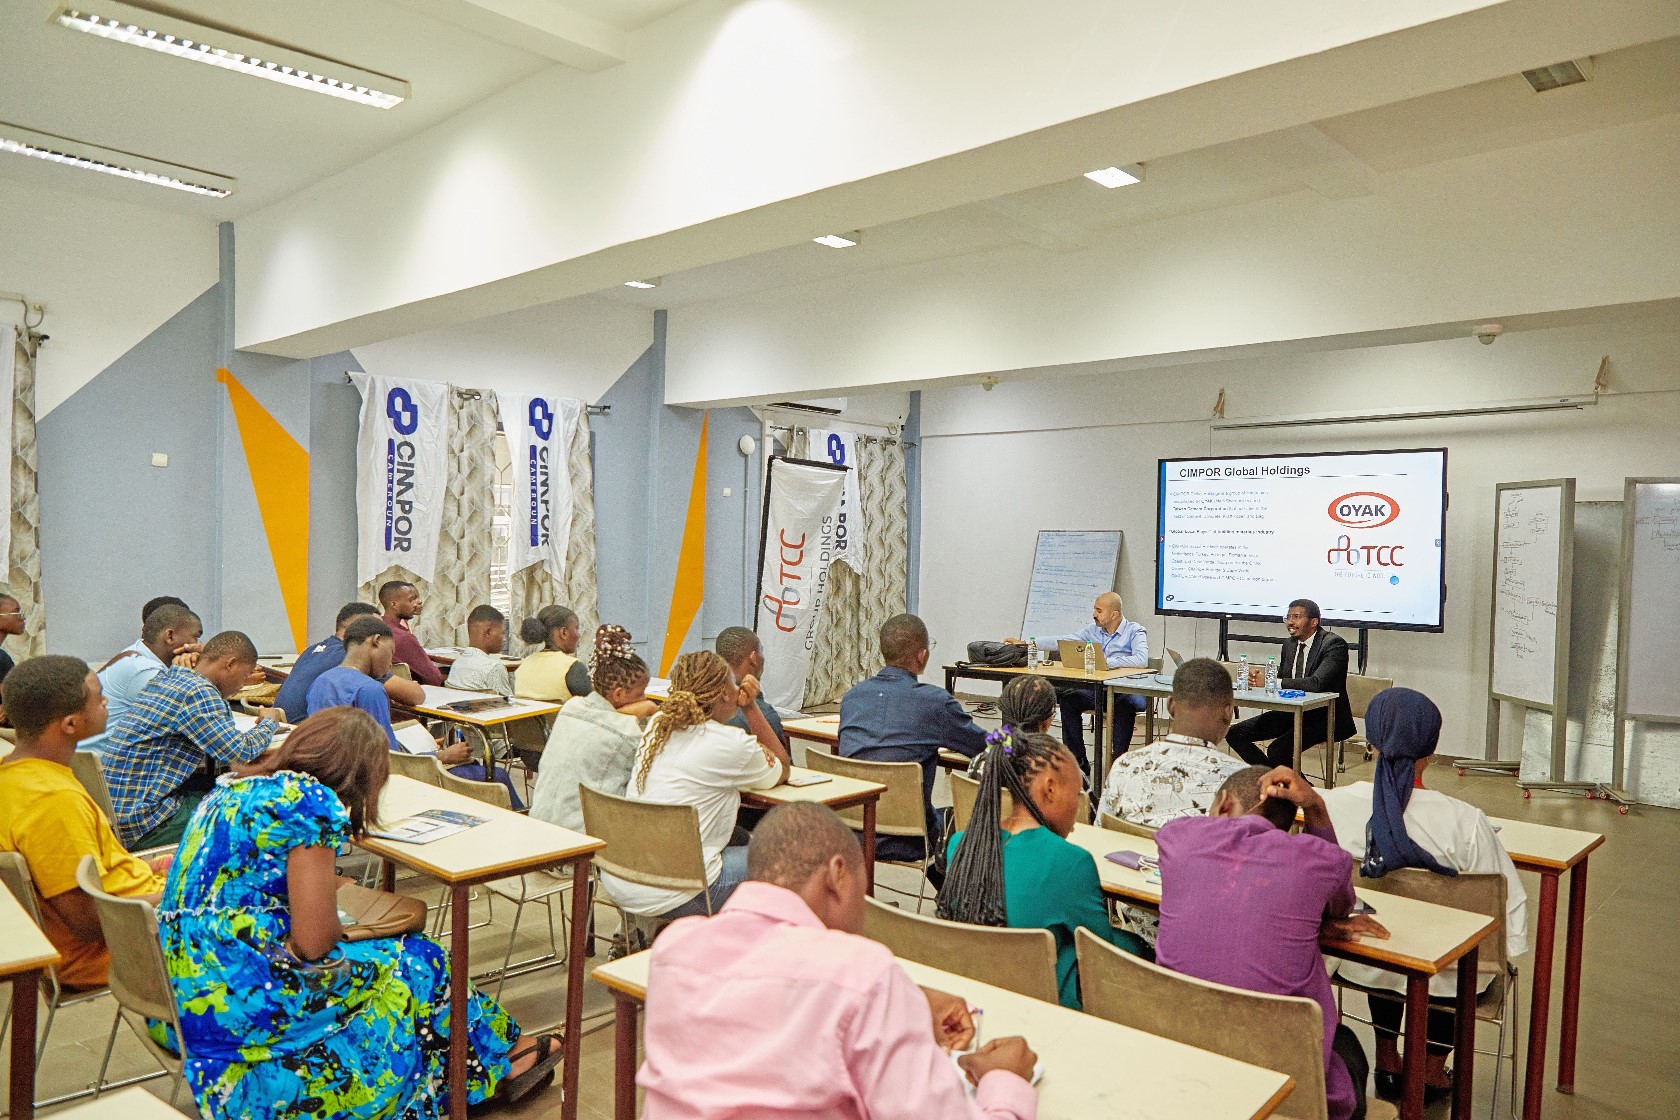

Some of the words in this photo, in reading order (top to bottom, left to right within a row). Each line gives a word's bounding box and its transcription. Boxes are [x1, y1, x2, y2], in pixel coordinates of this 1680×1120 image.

[386, 454, 394, 527] CAMEROUN
[394, 441, 415, 552] CIMPOR
[530, 459, 538, 525] CAMEROUN
[1179, 467, 1221, 478] CIMPOR
[1224, 466, 1258, 477] Global
[1261, 465, 1311, 477] Holdings
[1339, 504, 1386, 517] OYAK
[780, 527, 806, 586] TCC
[818, 515, 832, 593] HOLDINGS
[1360, 545, 1404, 567] TCC
